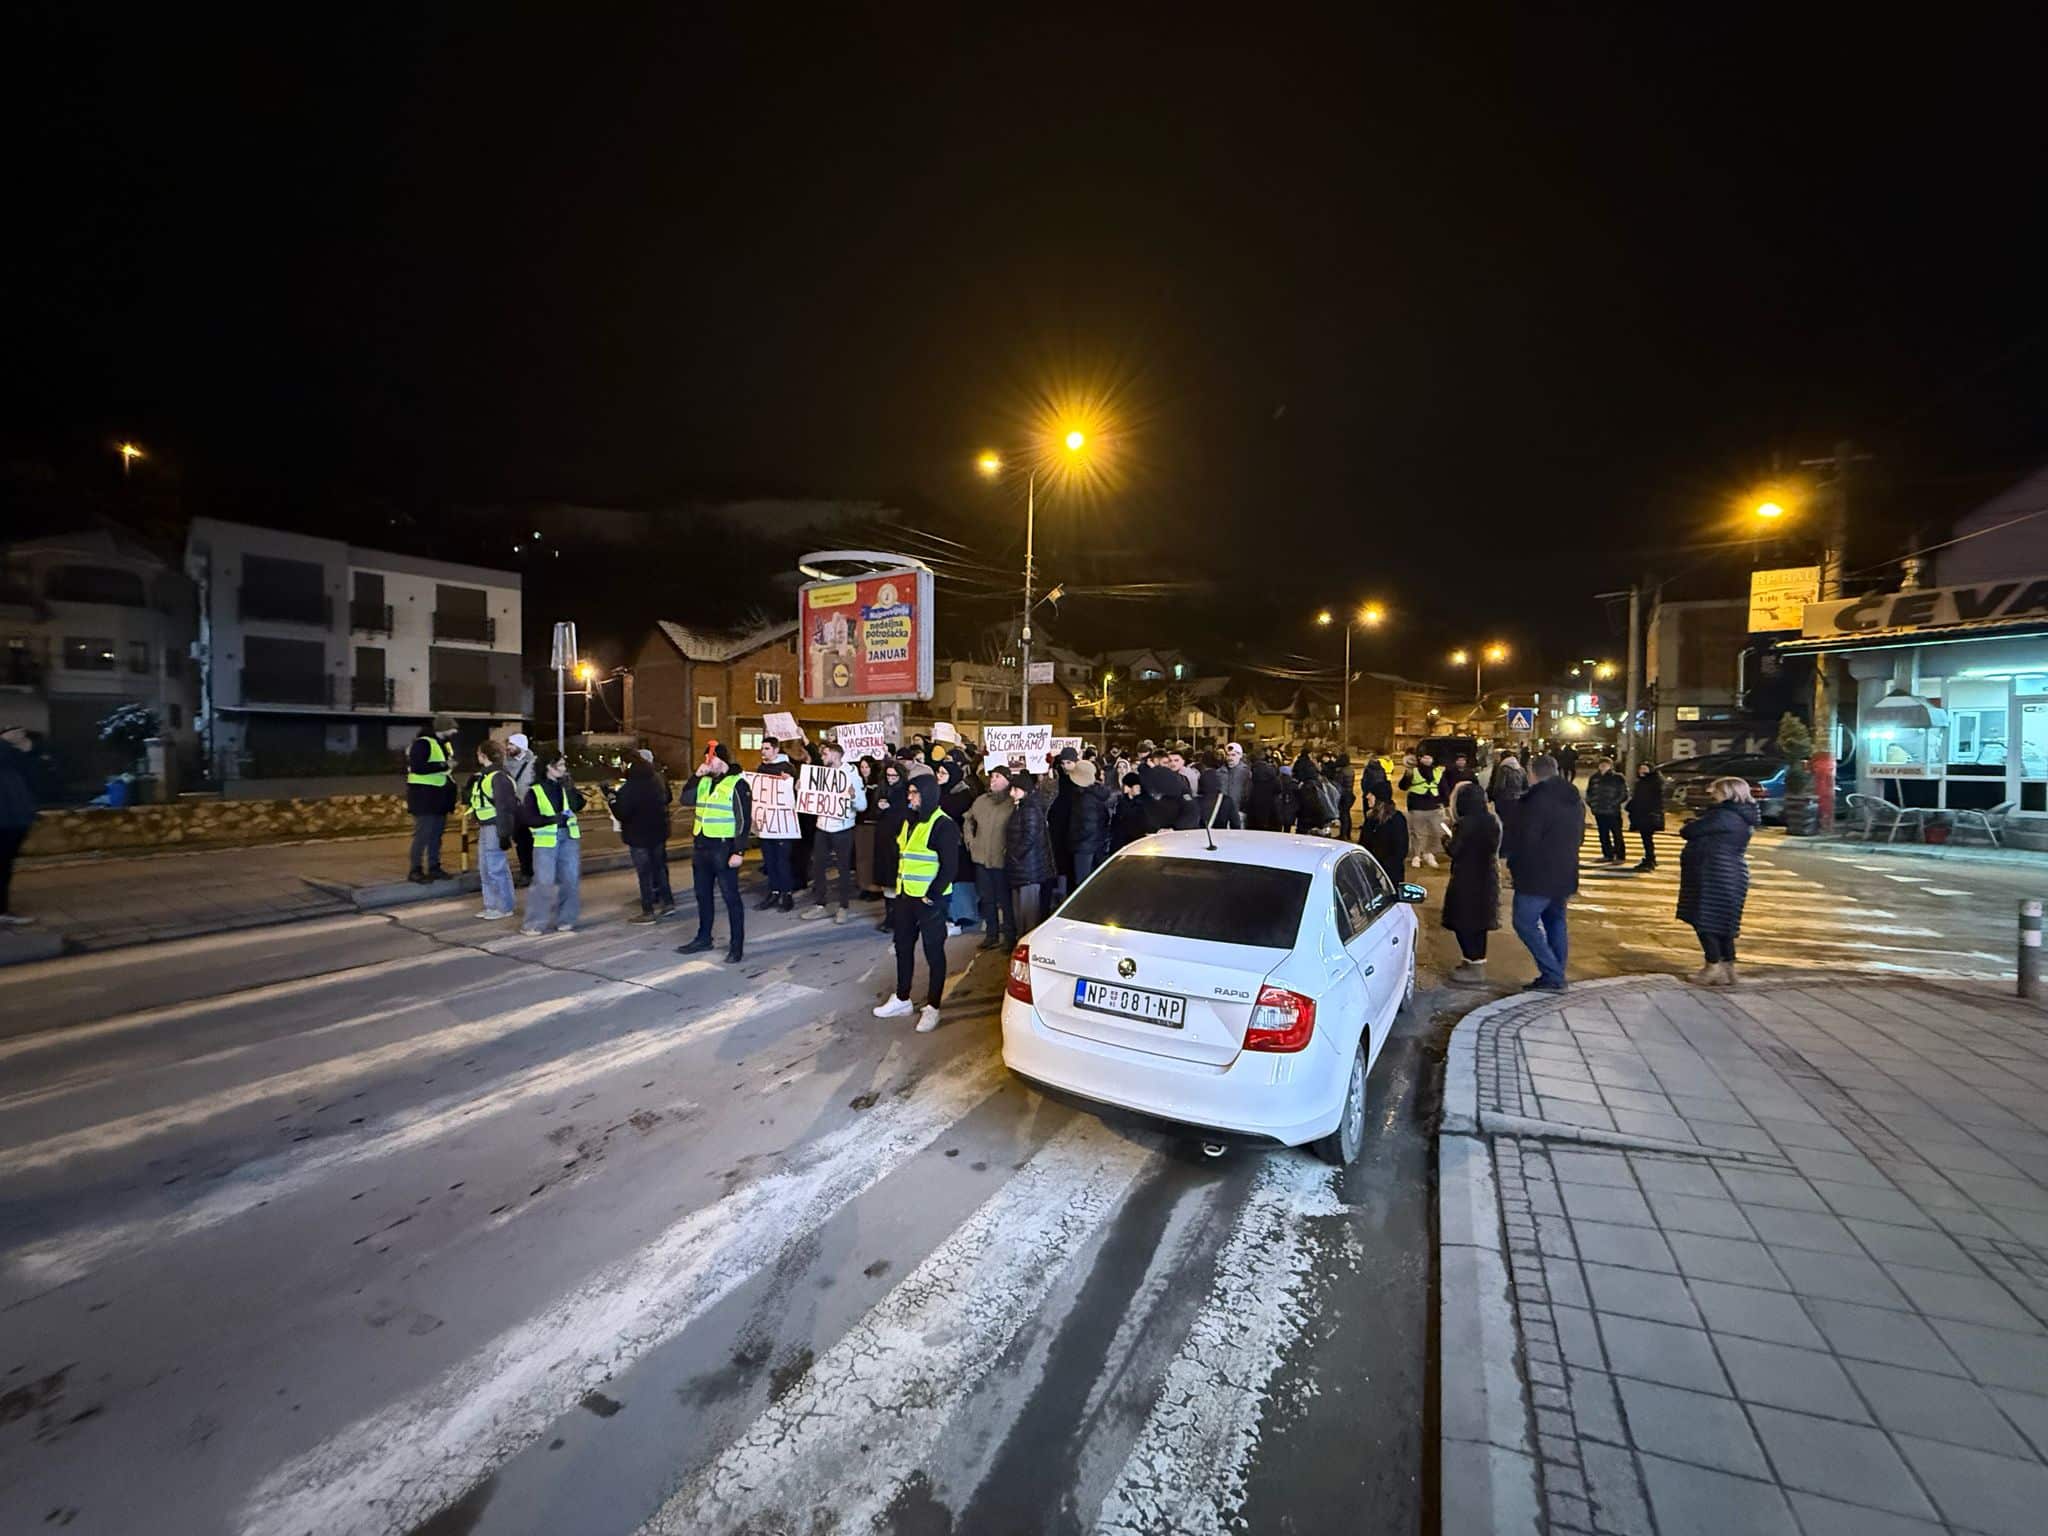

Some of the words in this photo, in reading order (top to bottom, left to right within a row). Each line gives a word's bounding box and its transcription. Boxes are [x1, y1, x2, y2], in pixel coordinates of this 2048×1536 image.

[869, 647, 907, 661] JANUAR
[989, 739, 1045, 752] BLOKIRAMO
[808, 767, 847, 794] NIKAD
[799, 793, 815, 812] NE
[816, 793, 836, 816] BOJ
[837, 796, 851, 818] SE
[1087, 984, 1107, 1006] NP
